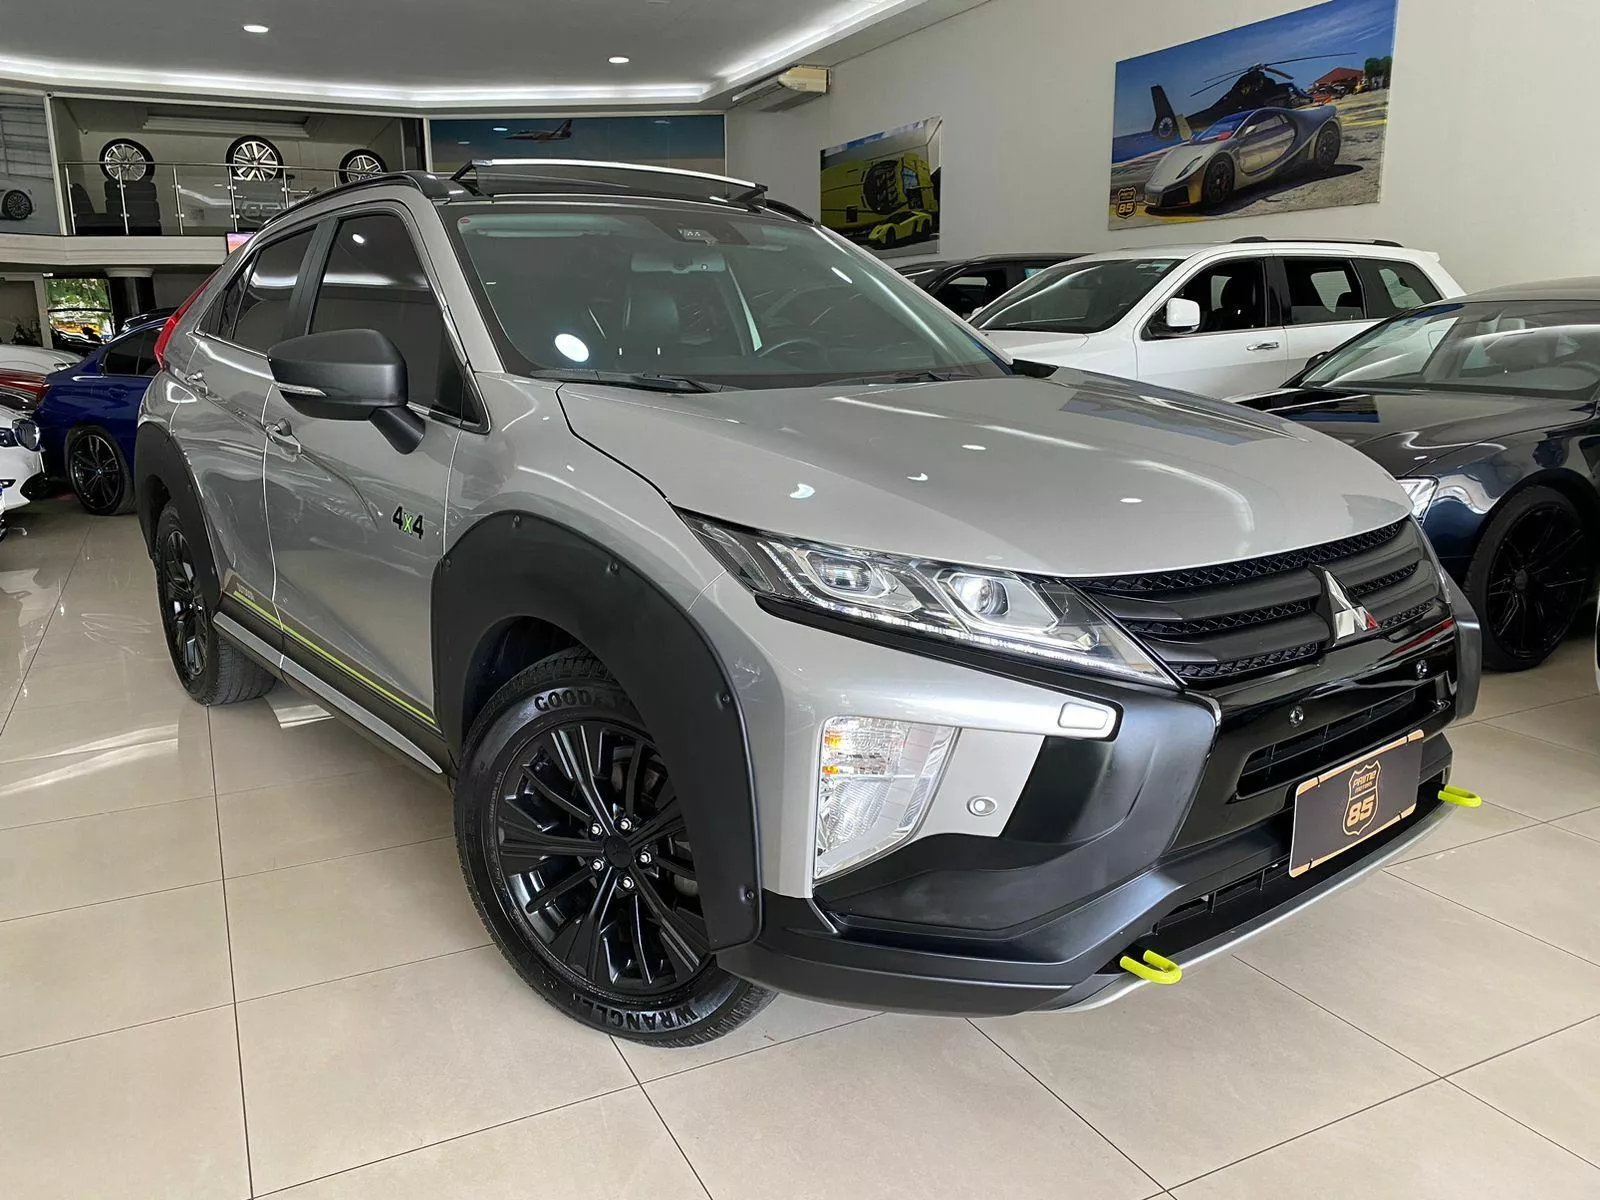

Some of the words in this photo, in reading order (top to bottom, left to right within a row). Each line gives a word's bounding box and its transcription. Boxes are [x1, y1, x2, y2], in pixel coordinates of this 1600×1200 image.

[1119, 203, 1134, 213] 85
[393, 505, 424, 540] 4x4
[1346, 795, 1376, 827] 85
